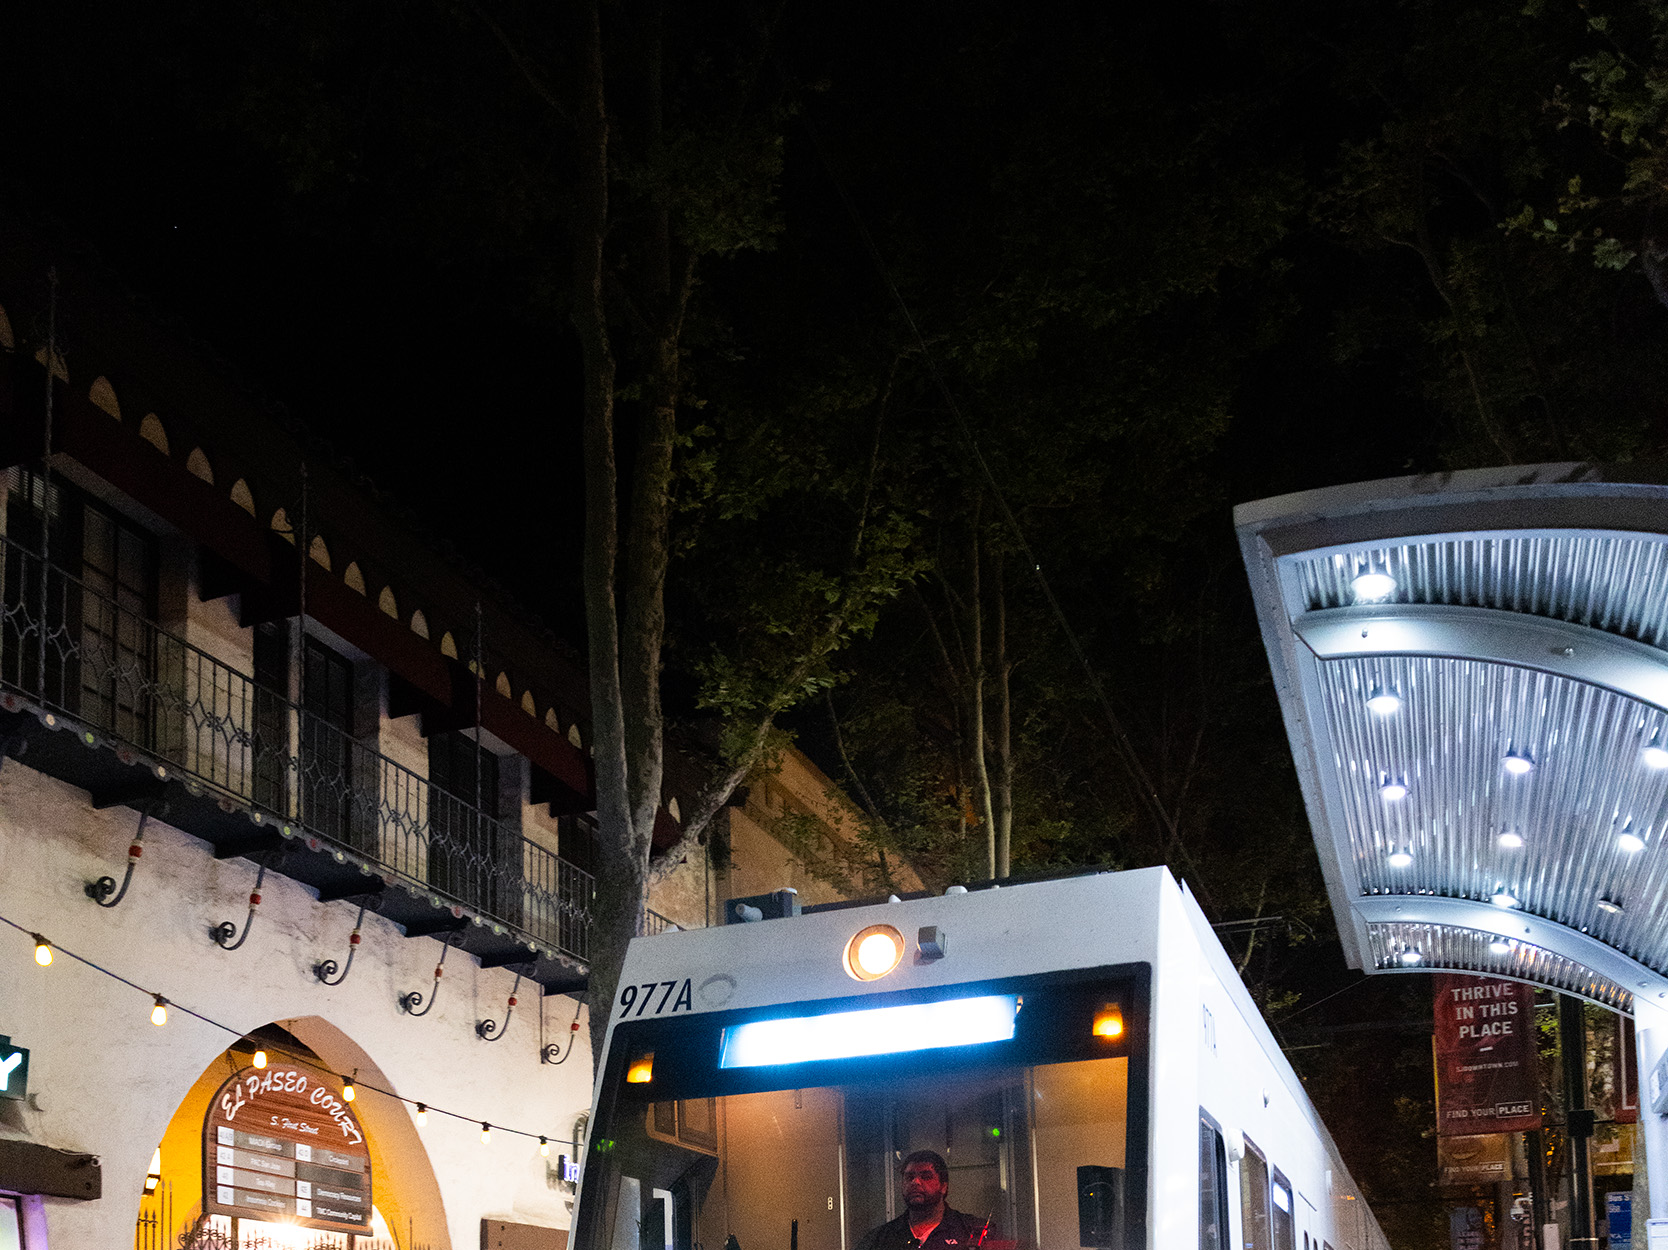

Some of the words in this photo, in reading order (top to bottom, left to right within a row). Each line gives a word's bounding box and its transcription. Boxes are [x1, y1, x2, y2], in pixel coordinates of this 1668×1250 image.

[619, 978, 692, 1018] 977A
[1451, 983, 1514, 1002] THRIVE
[1456, 1006, 1474, 1020] IN
[1479, 1001, 1518, 1018] THIS
[1459, 1021, 1513, 1038] PLACE
[221, 1084, 246, 1121] EL
[246, 1071, 307, 1100] PASEO
[310, 1087, 362, 1145] COURT
[1446, 1109, 1468, 1118] FIND
[1472, 1107, 1496, 1117] YOUR
[1498, 1104, 1530, 1115] PLACE
